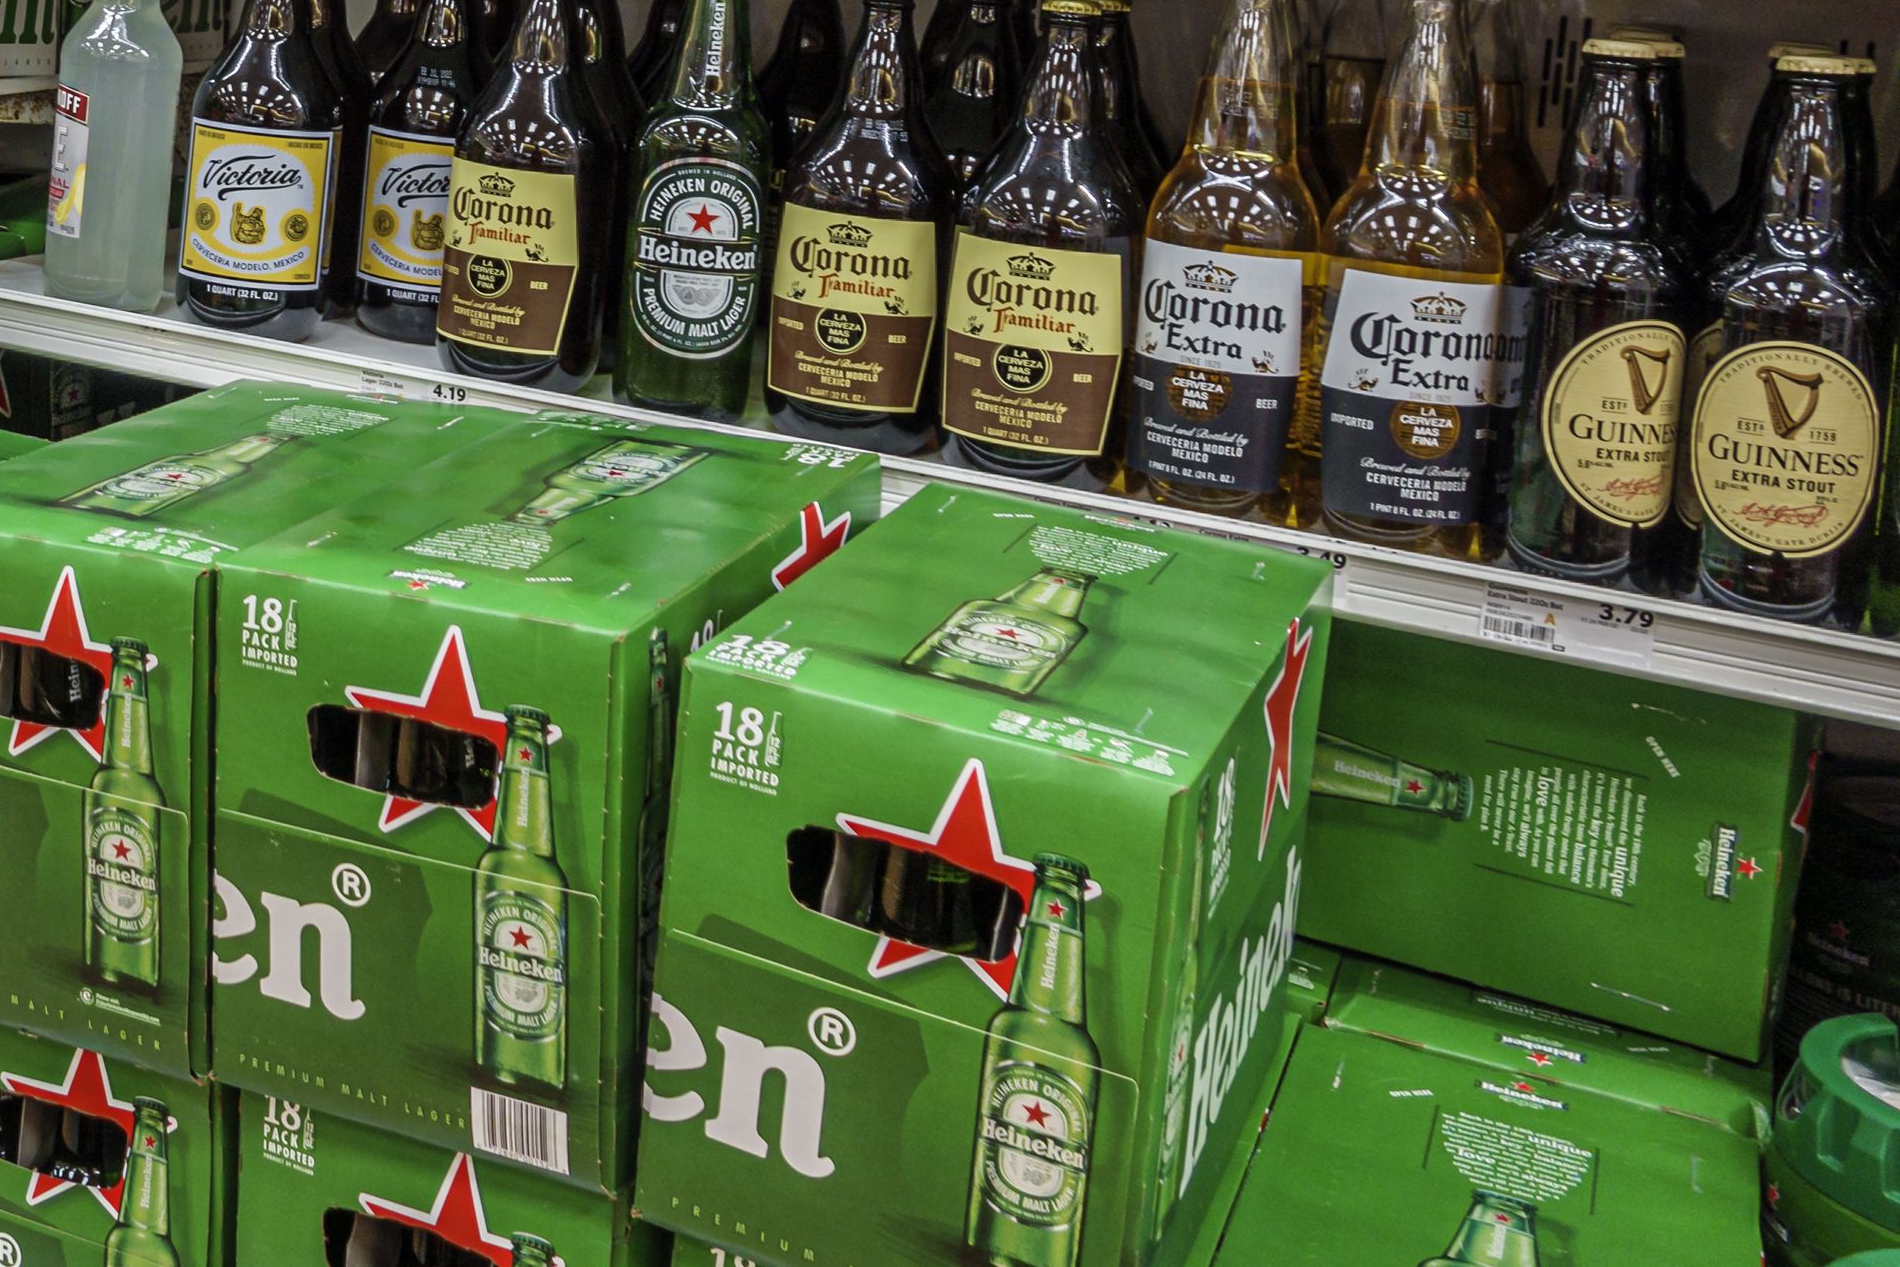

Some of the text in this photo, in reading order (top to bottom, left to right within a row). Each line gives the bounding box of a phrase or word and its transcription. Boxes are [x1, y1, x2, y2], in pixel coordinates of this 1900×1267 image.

[203, 154, 302, 201] Victoria
[454, 187, 555, 231] Corona
[709, 179, 755, 230] ORIGINAL
[468, 222, 531, 245] Familiar
[638, 236, 756, 270] Heineken
[1144, 280, 1286, 335] Corona
[1165, 324, 1242, 360] Extra
[433, 383, 467, 403] 4.19
[1073, 373, 1092, 384] BEER
[1390, 357, 1470, 393] Extra
[1147, 433, 1244, 458] CERVECERIA MODELO
[1707, 433, 1860, 479] GUINNESS
[1731, 468, 1836, 494] EXTRA STOUT
[241, 595, 283, 632] 18
[1599, 603, 1654, 628] 3.79
[241, 630, 281, 651] PACK
[241, 647, 298, 668] IMPORTED
[1645, 735, 1680, 779] OPEN HERE
[479, 946, 563, 982] Heineken
[983, 1117, 1086, 1170] Heineken
